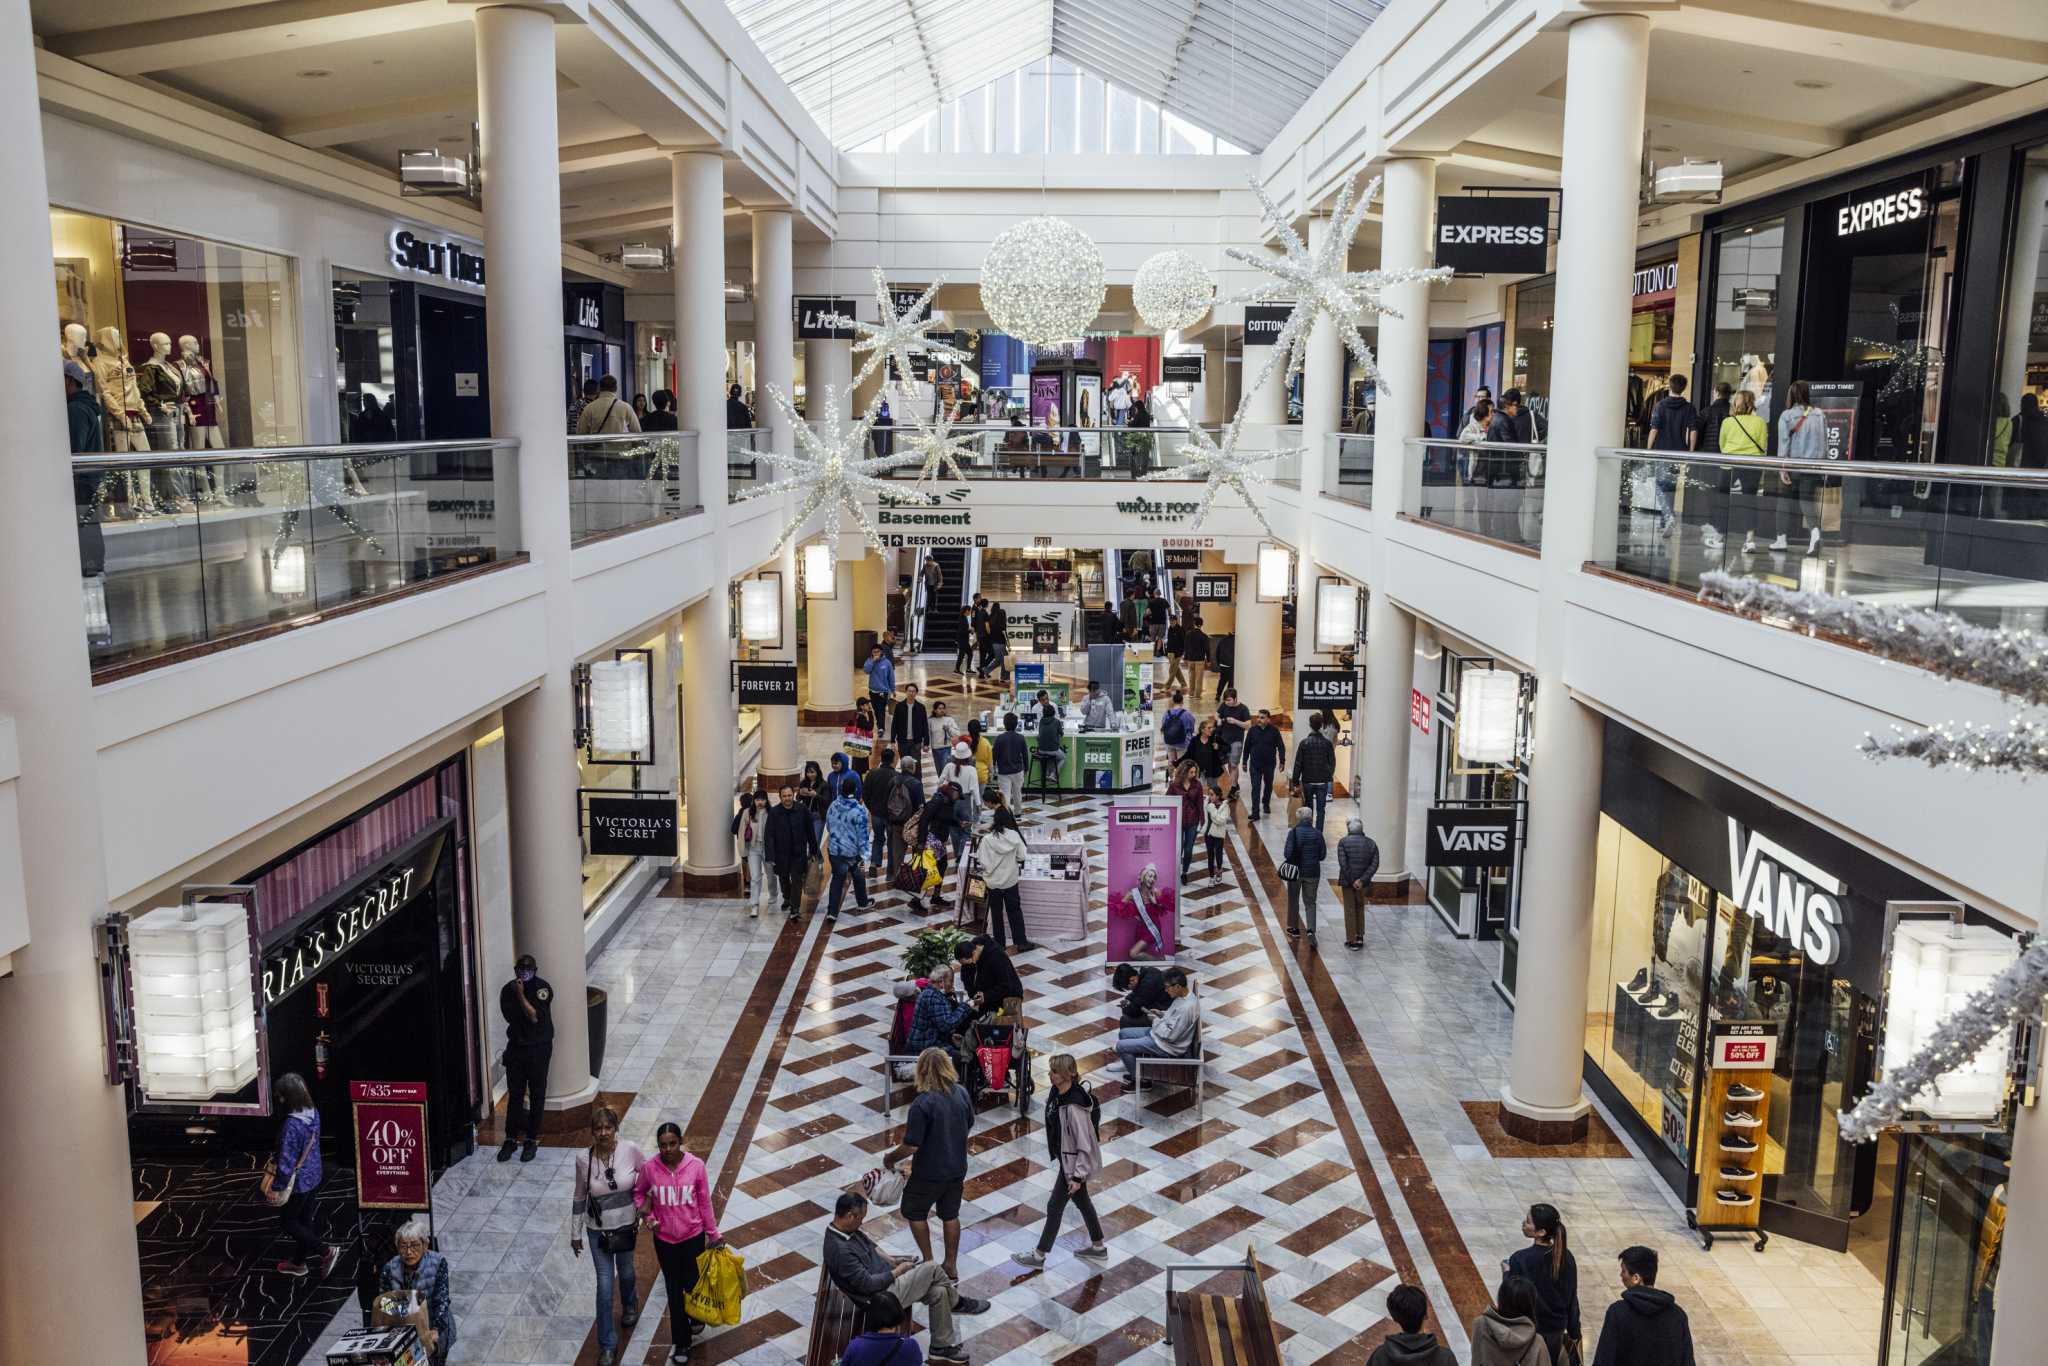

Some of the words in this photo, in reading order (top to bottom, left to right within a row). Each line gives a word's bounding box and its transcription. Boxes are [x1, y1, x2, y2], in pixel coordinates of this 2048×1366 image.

[1838, 187, 1923, 236] EXPRESS
[1440, 225, 1544, 245] EXPRESS
[1632, 266, 1664, 296] OTTON
[579, 298, 599, 328] Lids
[1248, 320, 1284, 331] COTTON
[879, 492, 941, 508] Sps
[1116, 496, 1162, 513] WHOLE
[1166, 502, 1200, 513] FOO
[878, 511, 971, 525] Basement
[907, 536, 972, 546] RESTROOMS
[1162, 538, 1203, 547] BOUDIN
[1007, 614, 1039, 624] orts
[741, 680, 781, 691] FOREVER
[785, 680, 795, 691] 21
[1303, 680, 1353, 695] LUSH
[1126, 736, 1150, 751] FREE
[1084, 752, 1112, 763] FREE
[595, 816, 671, 829] VICTORIA'S
[609, 828, 657, 839] SECRET
[1436, 826, 1508, 851] VANS
[1728, 815, 1848, 966] VANS
[263, 932, 326, 1003] RIA'S
[334, 868, 414, 953] SECRET
[345, 962, 414, 975] VICTORIA'S
[357, 975, 400, 985] SECRET
[1680, 1021, 1697, 1041] FOR
[366, 1120, 416, 1147] 40%
[372, 1147, 412, 1164] OFF
